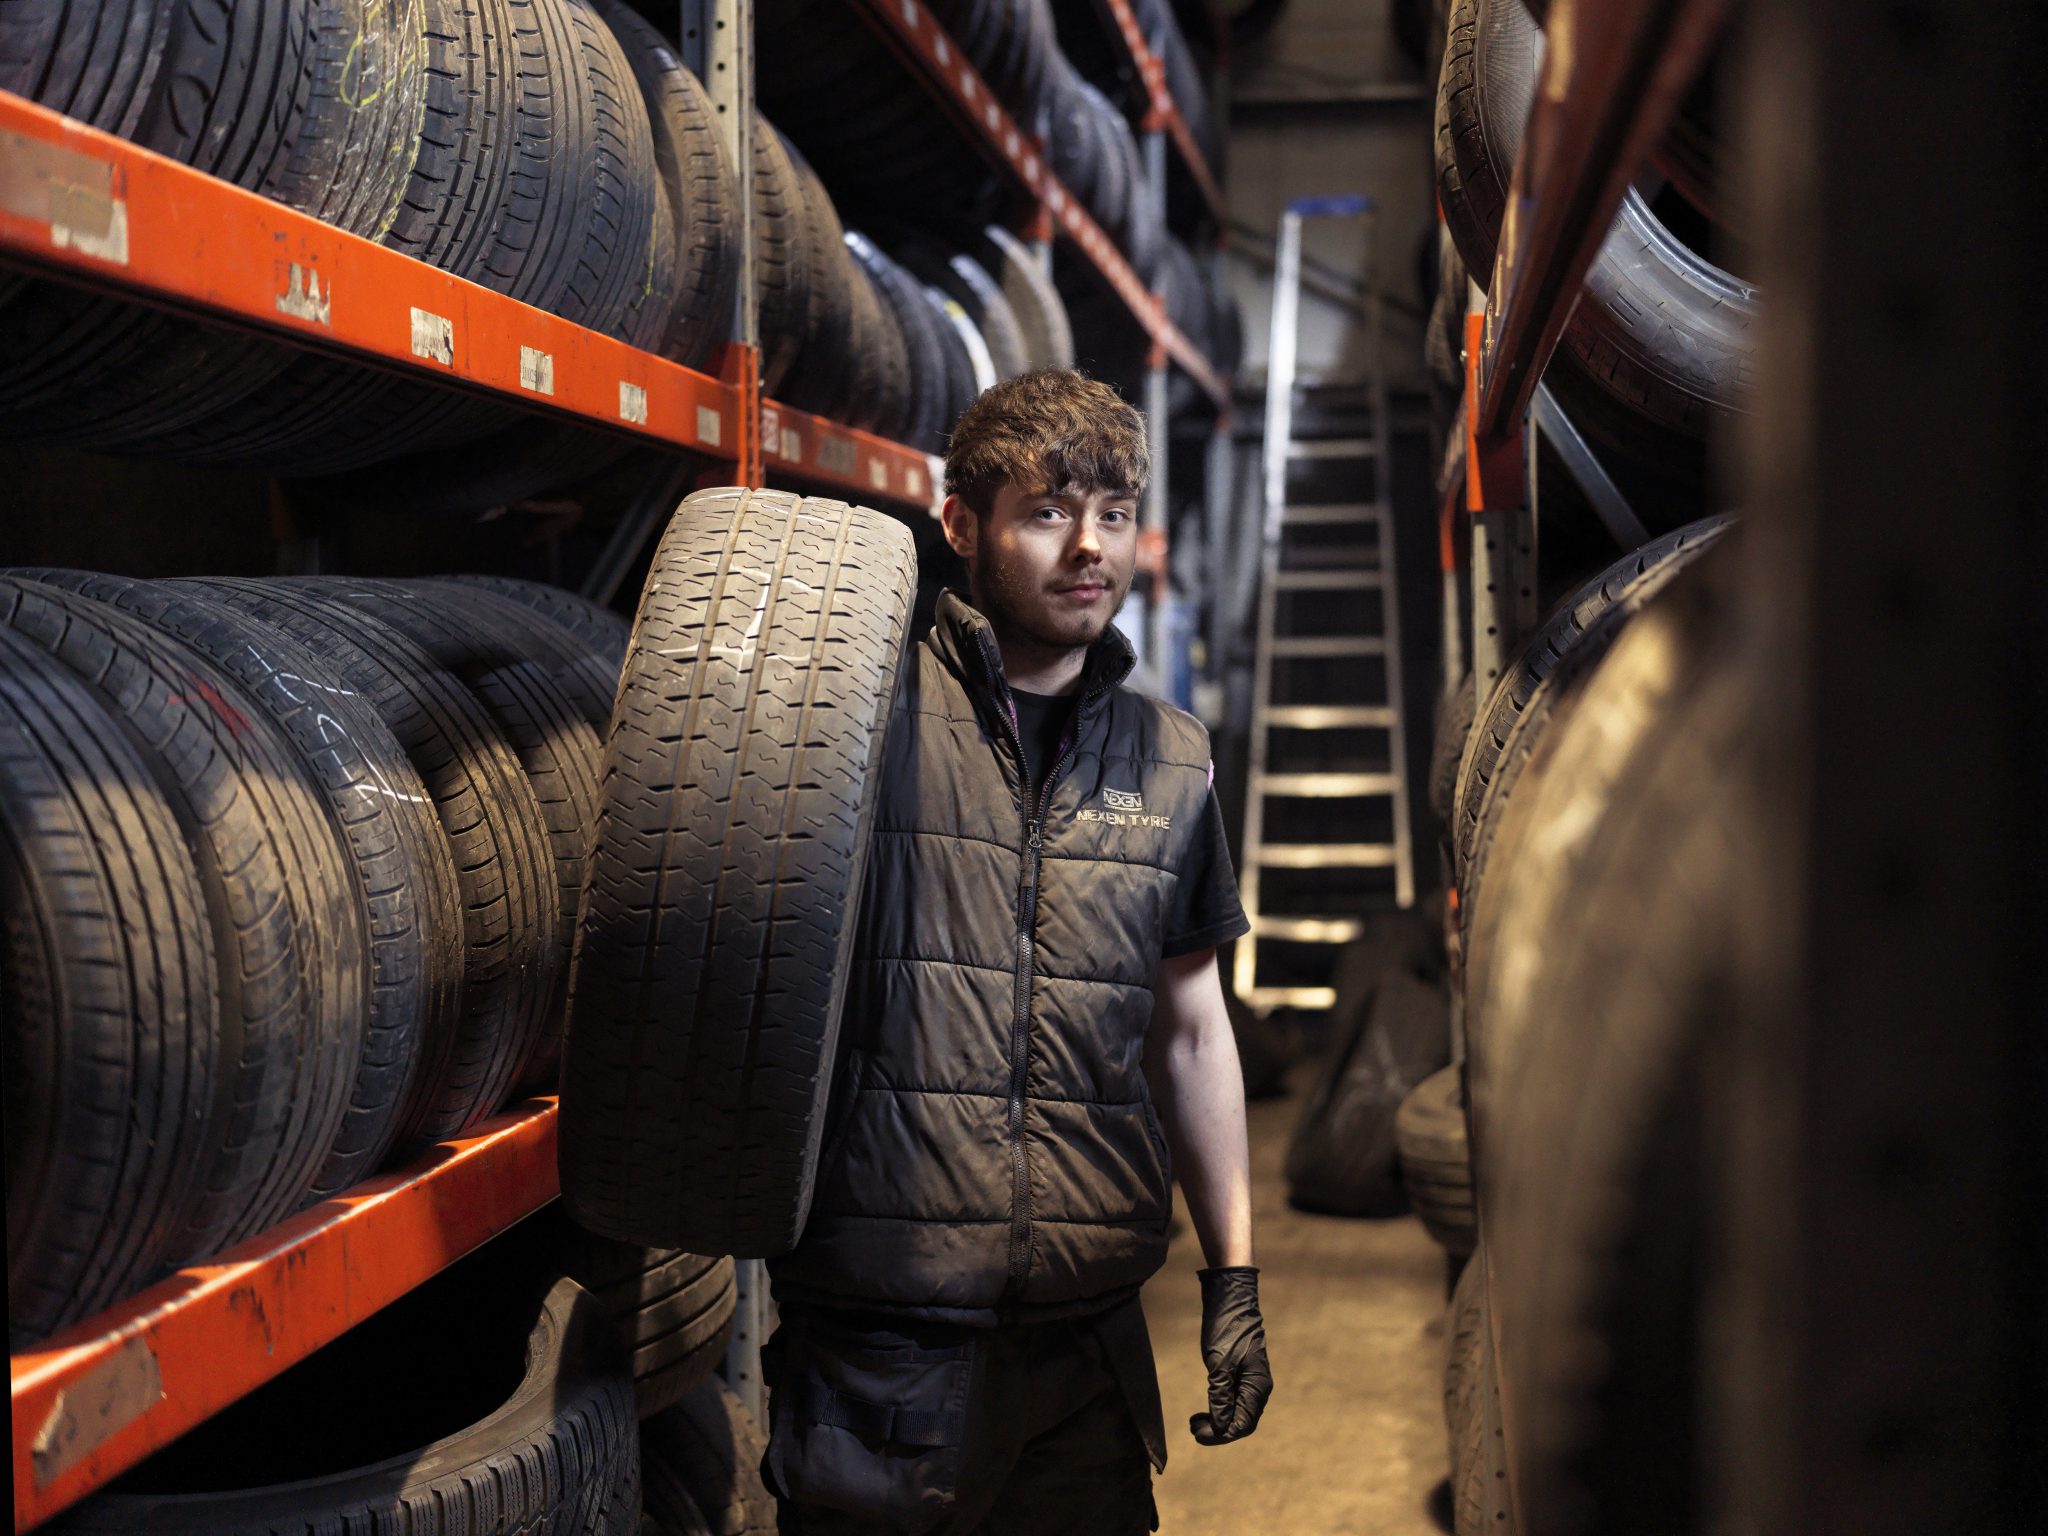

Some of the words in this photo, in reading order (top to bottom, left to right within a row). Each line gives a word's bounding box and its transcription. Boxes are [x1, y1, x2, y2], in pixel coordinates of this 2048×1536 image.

[1103, 789, 1142, 808] NEXEN
[1076, 809, 1126, 826] NEXEN
[1128, 814, 1171, 830] TYRE
